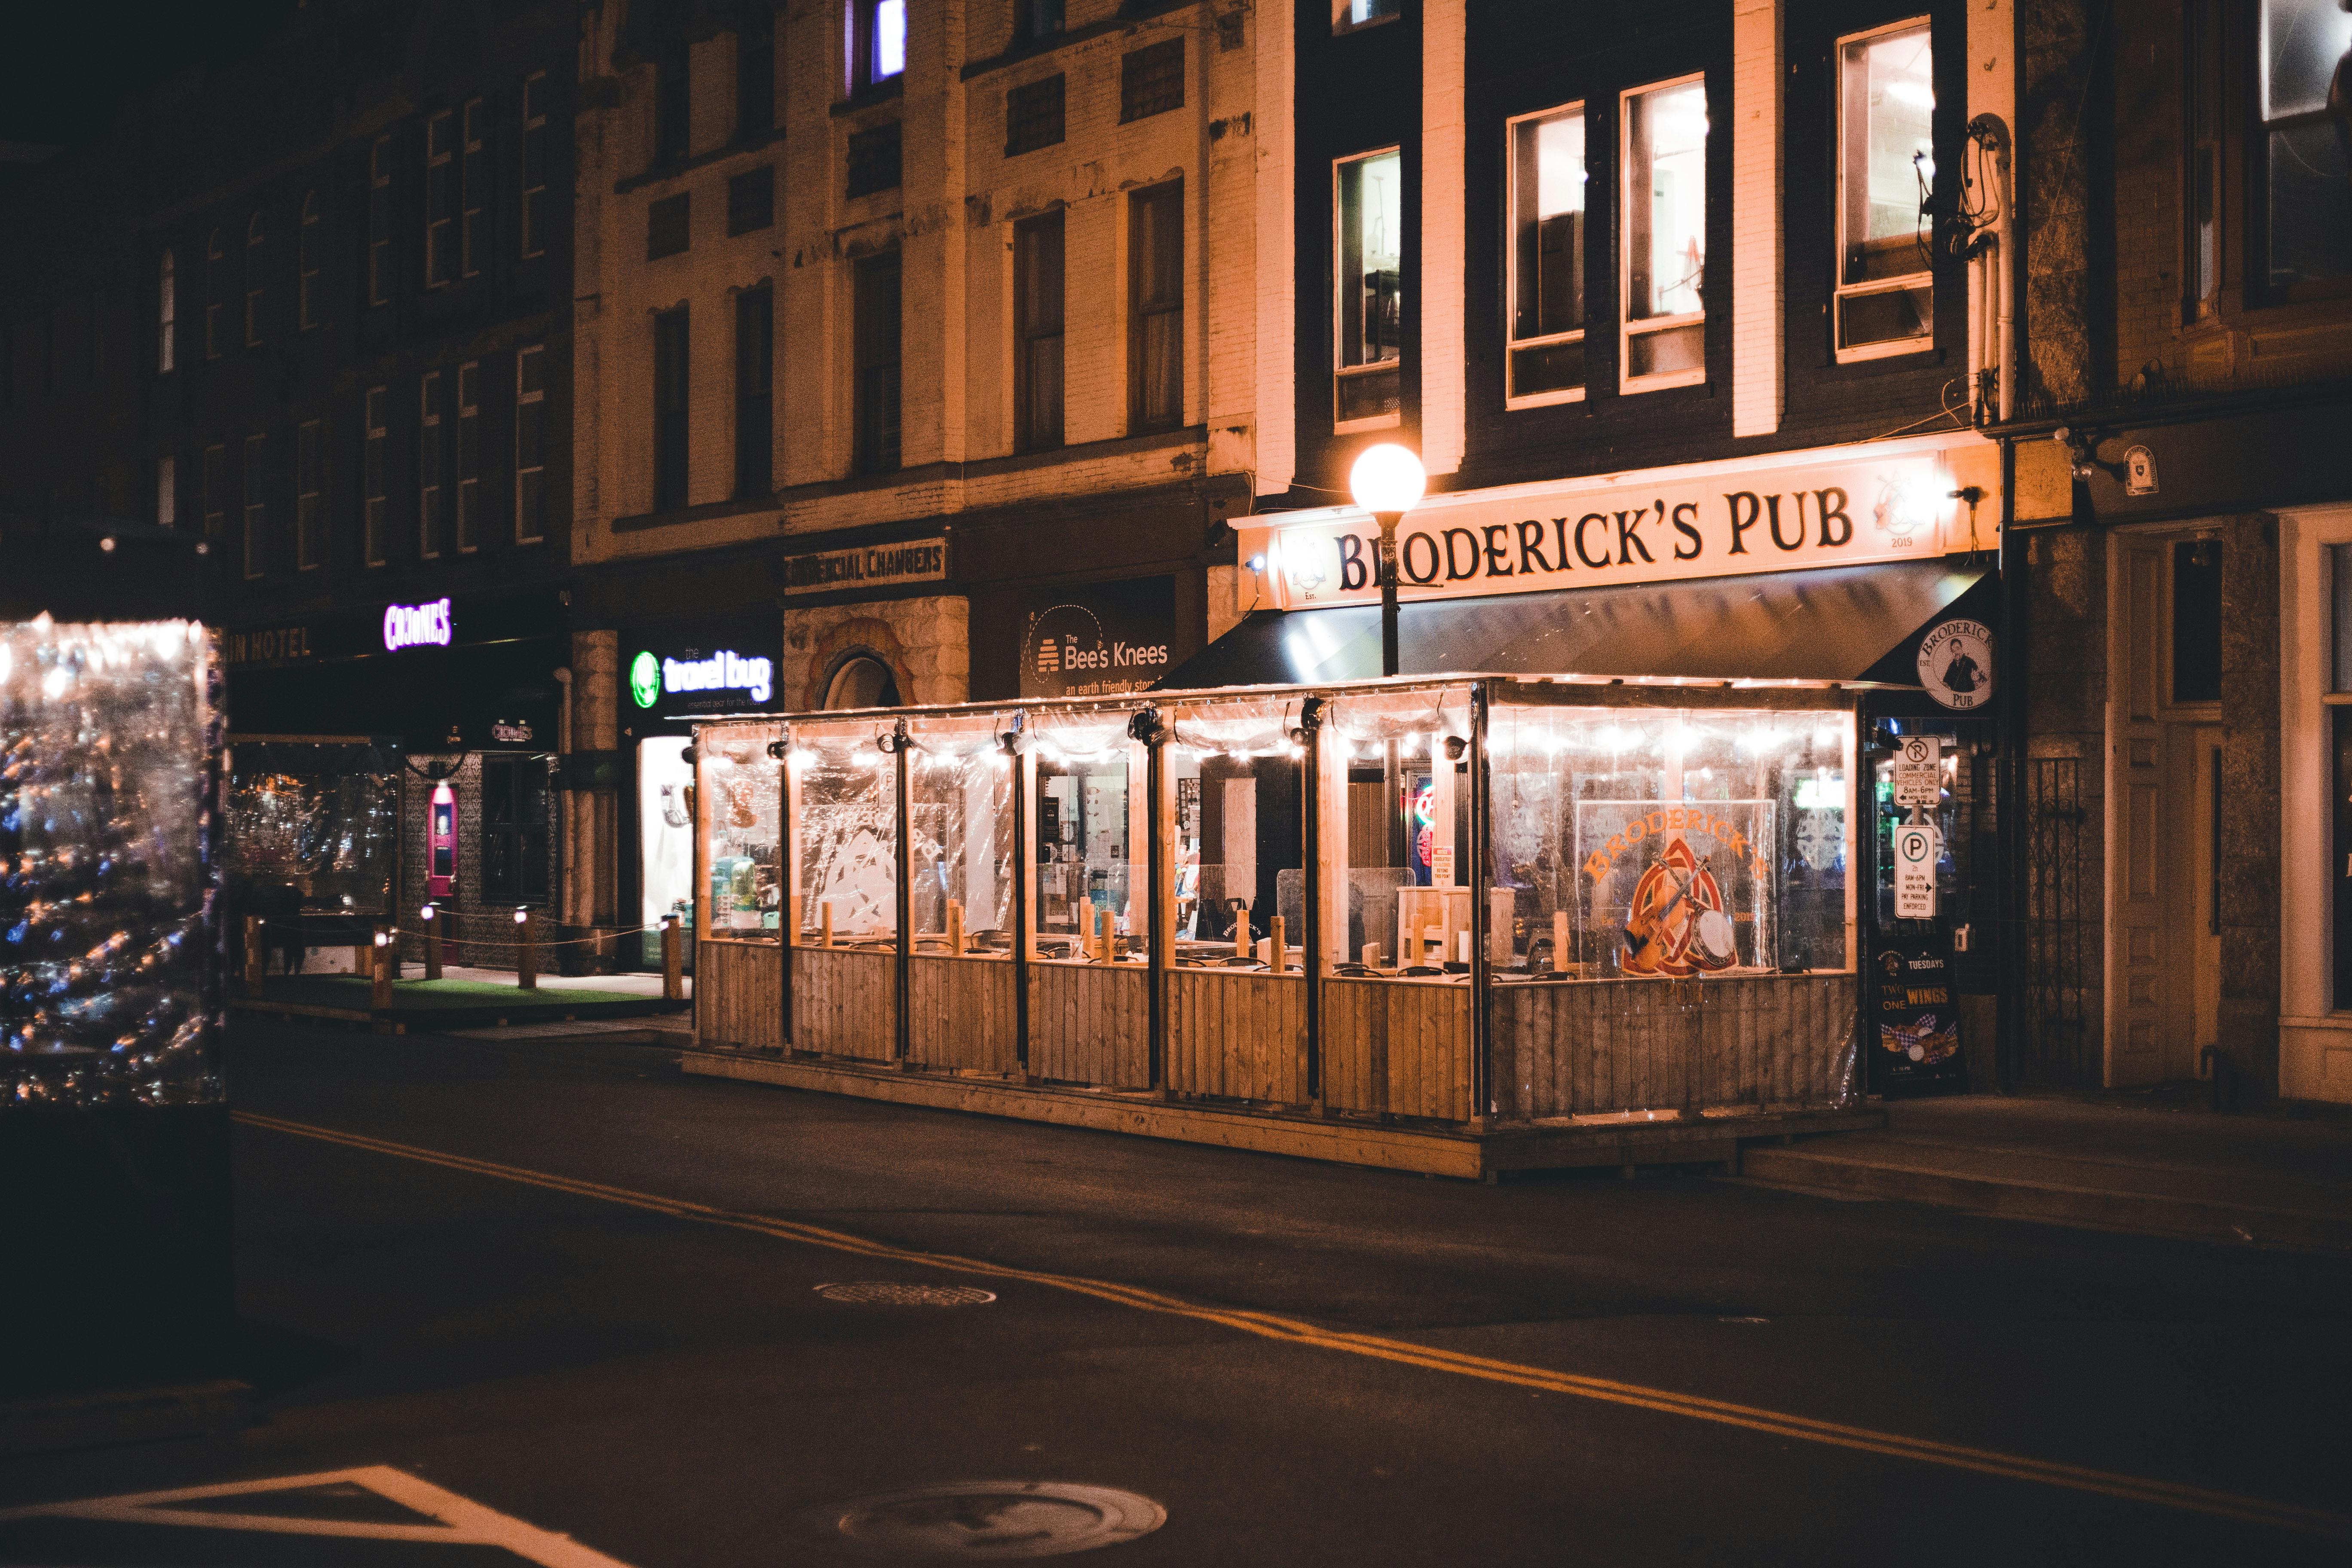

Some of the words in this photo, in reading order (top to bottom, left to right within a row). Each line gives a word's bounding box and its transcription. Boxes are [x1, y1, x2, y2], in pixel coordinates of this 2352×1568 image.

[1722, 487, 1854, 556] PUB
[1892, 537, 1913, 548] 2019
[867, 545, 942, 578] CHAMBERS
[251, 627, 310, 660] HOTEL
[1066, 634, 1078, 644] The
[685, 646, 699, 659] the
[1114, 641, 1168, 667] Knees
[662, 650, 724, 693] travel
[726, 649, 772, 702] bug
[1066, 685, 1075, 696] an
[1078, 682, 1099, 695] earth
[1102, 679, 1132, 694] friendly
[726, 698, 735, 707] for
[736, 697, 745, 706] the
[1953, 693, 1973, 706] PUB
[1583, 809, 1769, 884] BRODERICK'S
[1908, 959, 1944, 970] TUESDAYS
[1905, 986, 1949, 1005] WINGS
[1882, 999, 1907, 1011] ONE
